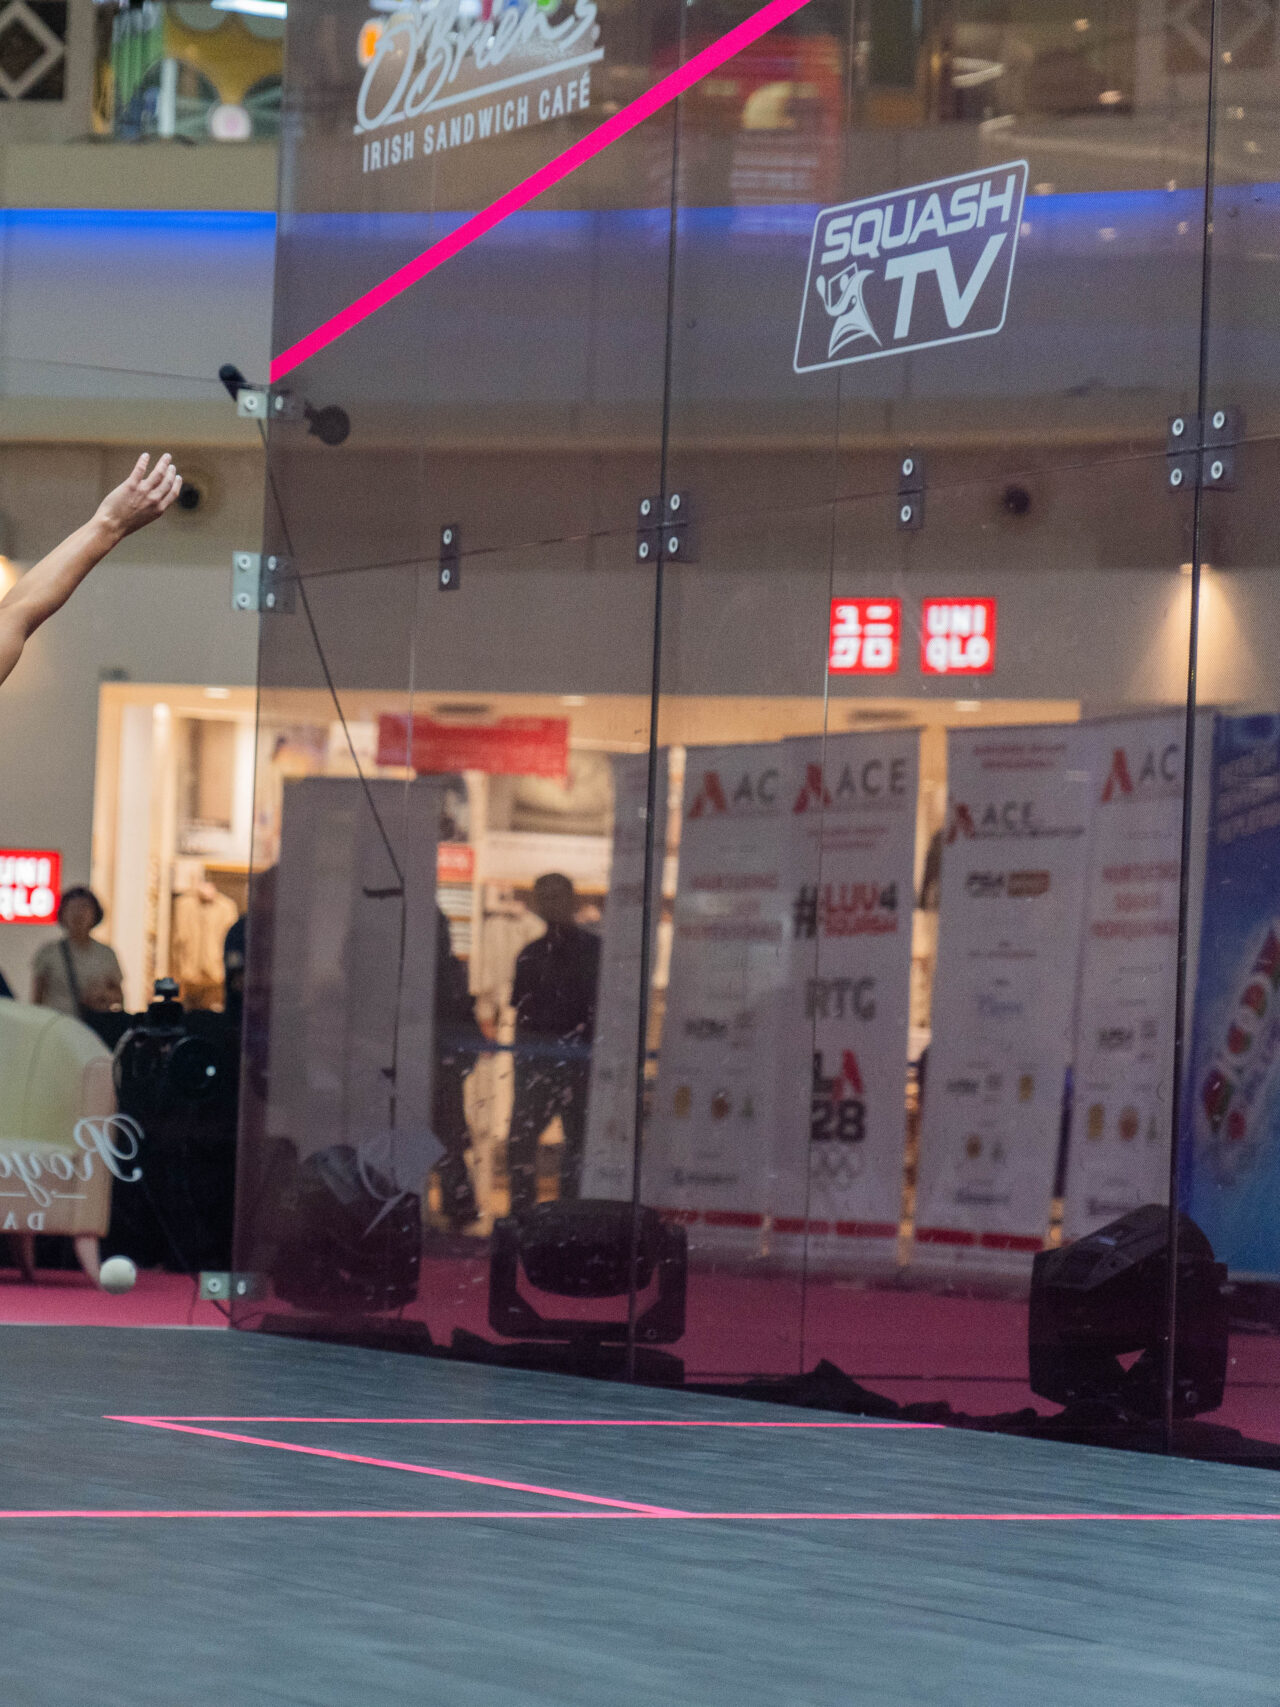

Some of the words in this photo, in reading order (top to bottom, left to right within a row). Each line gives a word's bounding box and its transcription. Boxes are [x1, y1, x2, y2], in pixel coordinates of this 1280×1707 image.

[362, 131, 415, 173] IRISH
[423, 95, 529, 155] SANDWICH
[538, 71, 591, 120] CAFÉ
[821, 174, 1016, 265] SQUASH
[885, 232, 1008, 339] TV
[927, 605, 987, 637] UNI
[926, 636, 991, 673] QLO
[836, 757, 907, 796] ACE
[1138, 742, 1179, 783] AC
[733, 768, 780, 803] AC
[811, 1099, 867, 1142] 28
